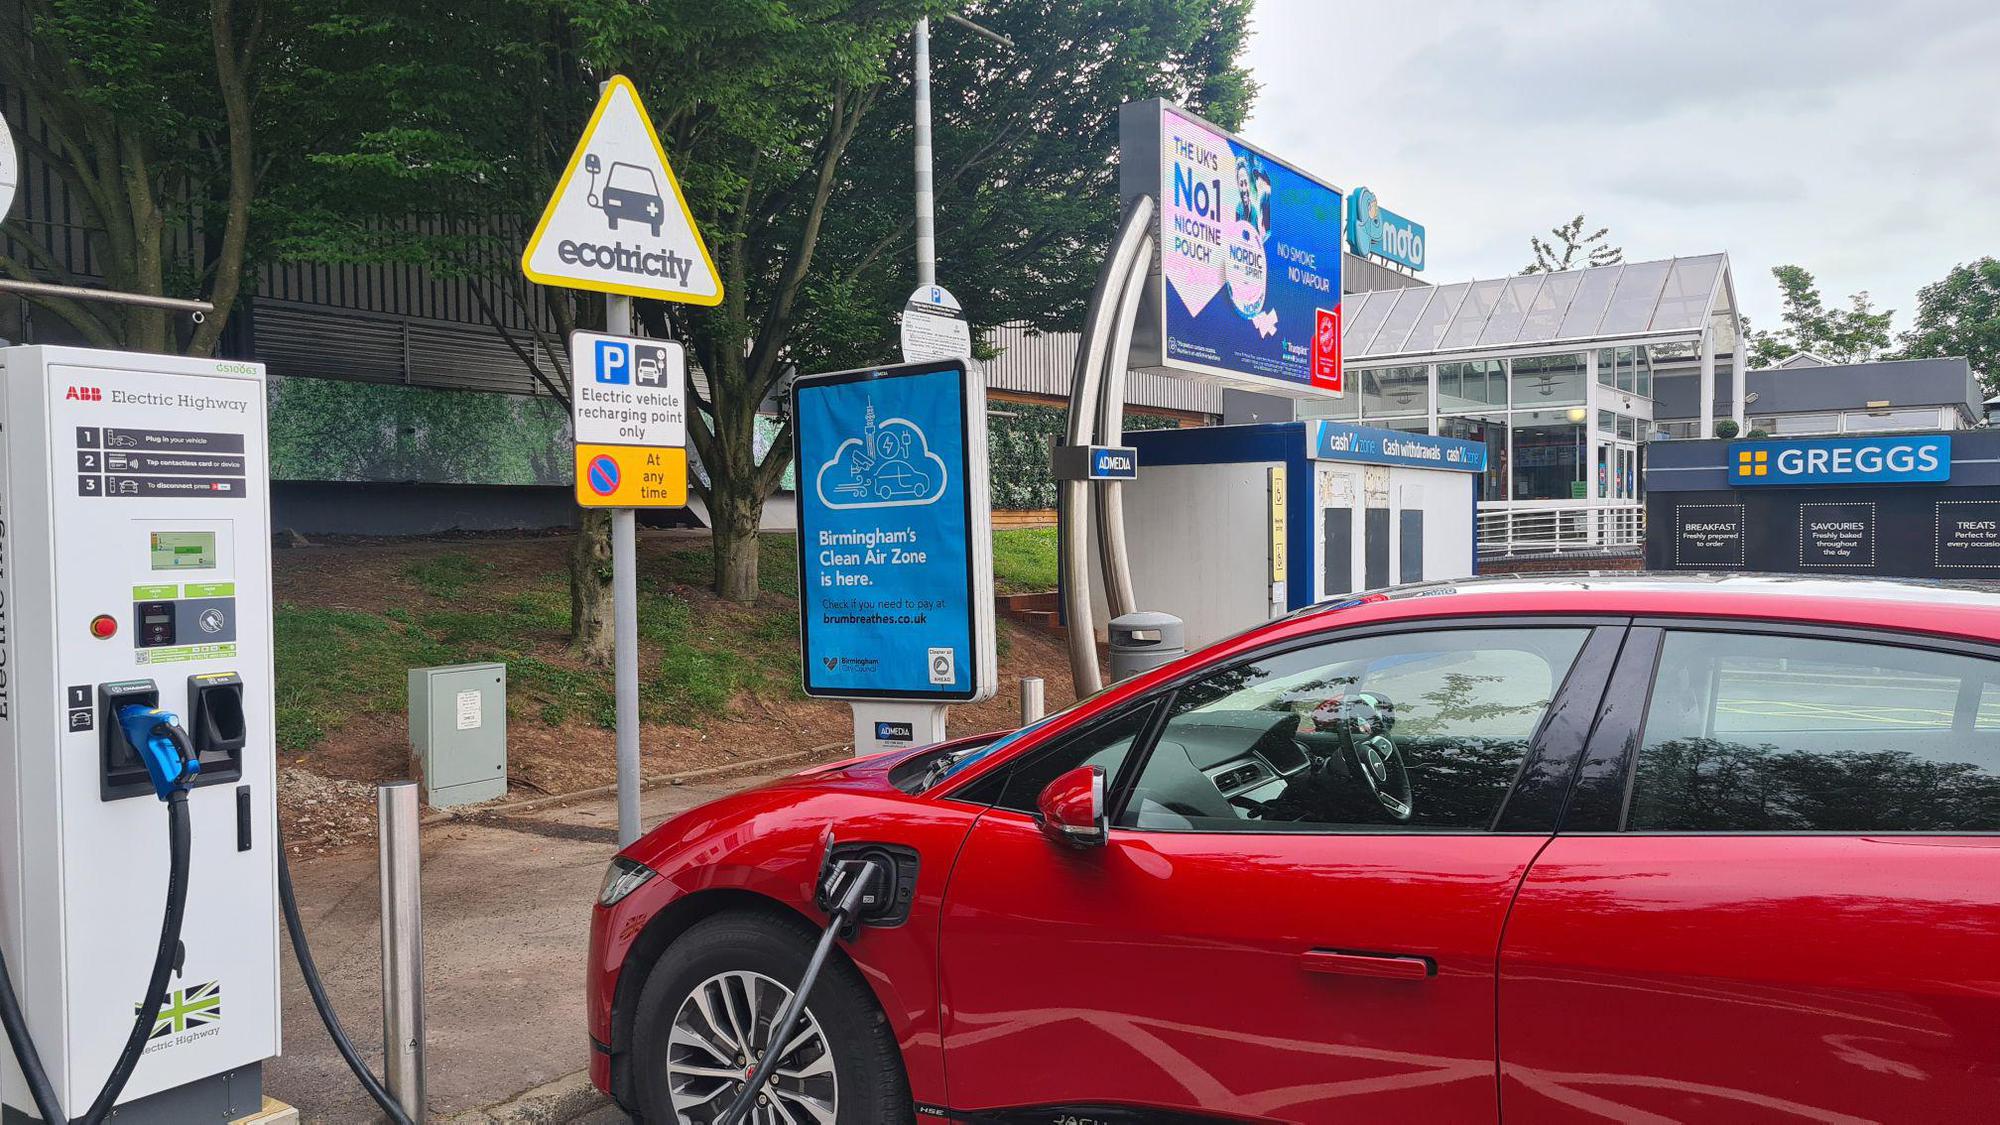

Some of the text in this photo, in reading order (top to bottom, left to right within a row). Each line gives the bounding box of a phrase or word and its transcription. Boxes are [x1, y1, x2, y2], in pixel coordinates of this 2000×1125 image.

[1174, 135, 1218, 171] THE UK'S
[1174, 160, 1220, 222] No.1
[1174, 213, 1221, 246] NICOTINE
[1277, 241, 1289, 258] NO
[1383, 222, 1422, 264] moto
[558, 239, 692, 287] ecotricity
[1229, 244, 1262, 269] NORDIC
[1245, 266, 1262, 280] SPIRIT
[1289, 266, 1330, 293] NO VAPOUR
[603, 345, 624, 380] P
[66, 386, 248, 412] ABB Electric Highway
[582, 388, 678, 407] Electric vehicle
[578, 406, 682, 424] recharging point
[84, 431, 91, 442] 1
[145, 435, 161, 443] Plug
[620, 425, 646, 440] only
[1330, 432, 1375, 454] cash zone
[1383, 438, 1440, 460] Cash withdrawals
[85, 456, 94, 466] 2
[646, 453, 660, 466] At
[1446, 447, 1479, 464] cash zone
[1777, 445, 1938, 474] GREGGS
[1099, 456, 1131, 470] ADMEDIA
[86, 479, 94, 490] 3
[643, 471, 664, 484] any
[641, 487, 668, 498] time
[1810, 522, 1864, 530] SAVOURIES
[1956, 521, 1996, 530] TREATS
[819, 527, 916, 548] Birmingham's
[1683, 532, 1738, 540] Freshly prepared
[1812, 532, 1838, 540] Freshly
[1816, 540, 1857, 548] throughout
[820, 548, 926, 566] Clean Air Zone
[1837, 549, 1850, 557] day
[821, 570, 872, 586] is here.
[822, 599, 946, 611] Check if you need to pay at
[823, 612, 926, 624] brumbreathes.co.uk
[841, 657, 878, 666] Birmingham
[76, 690, 82, 701] 1
[881, 727, 910, 736] ADMEDIA
[141, 1026, 220, 1056] lectric Highway
[920, 1106, 944, 1116] HSE
